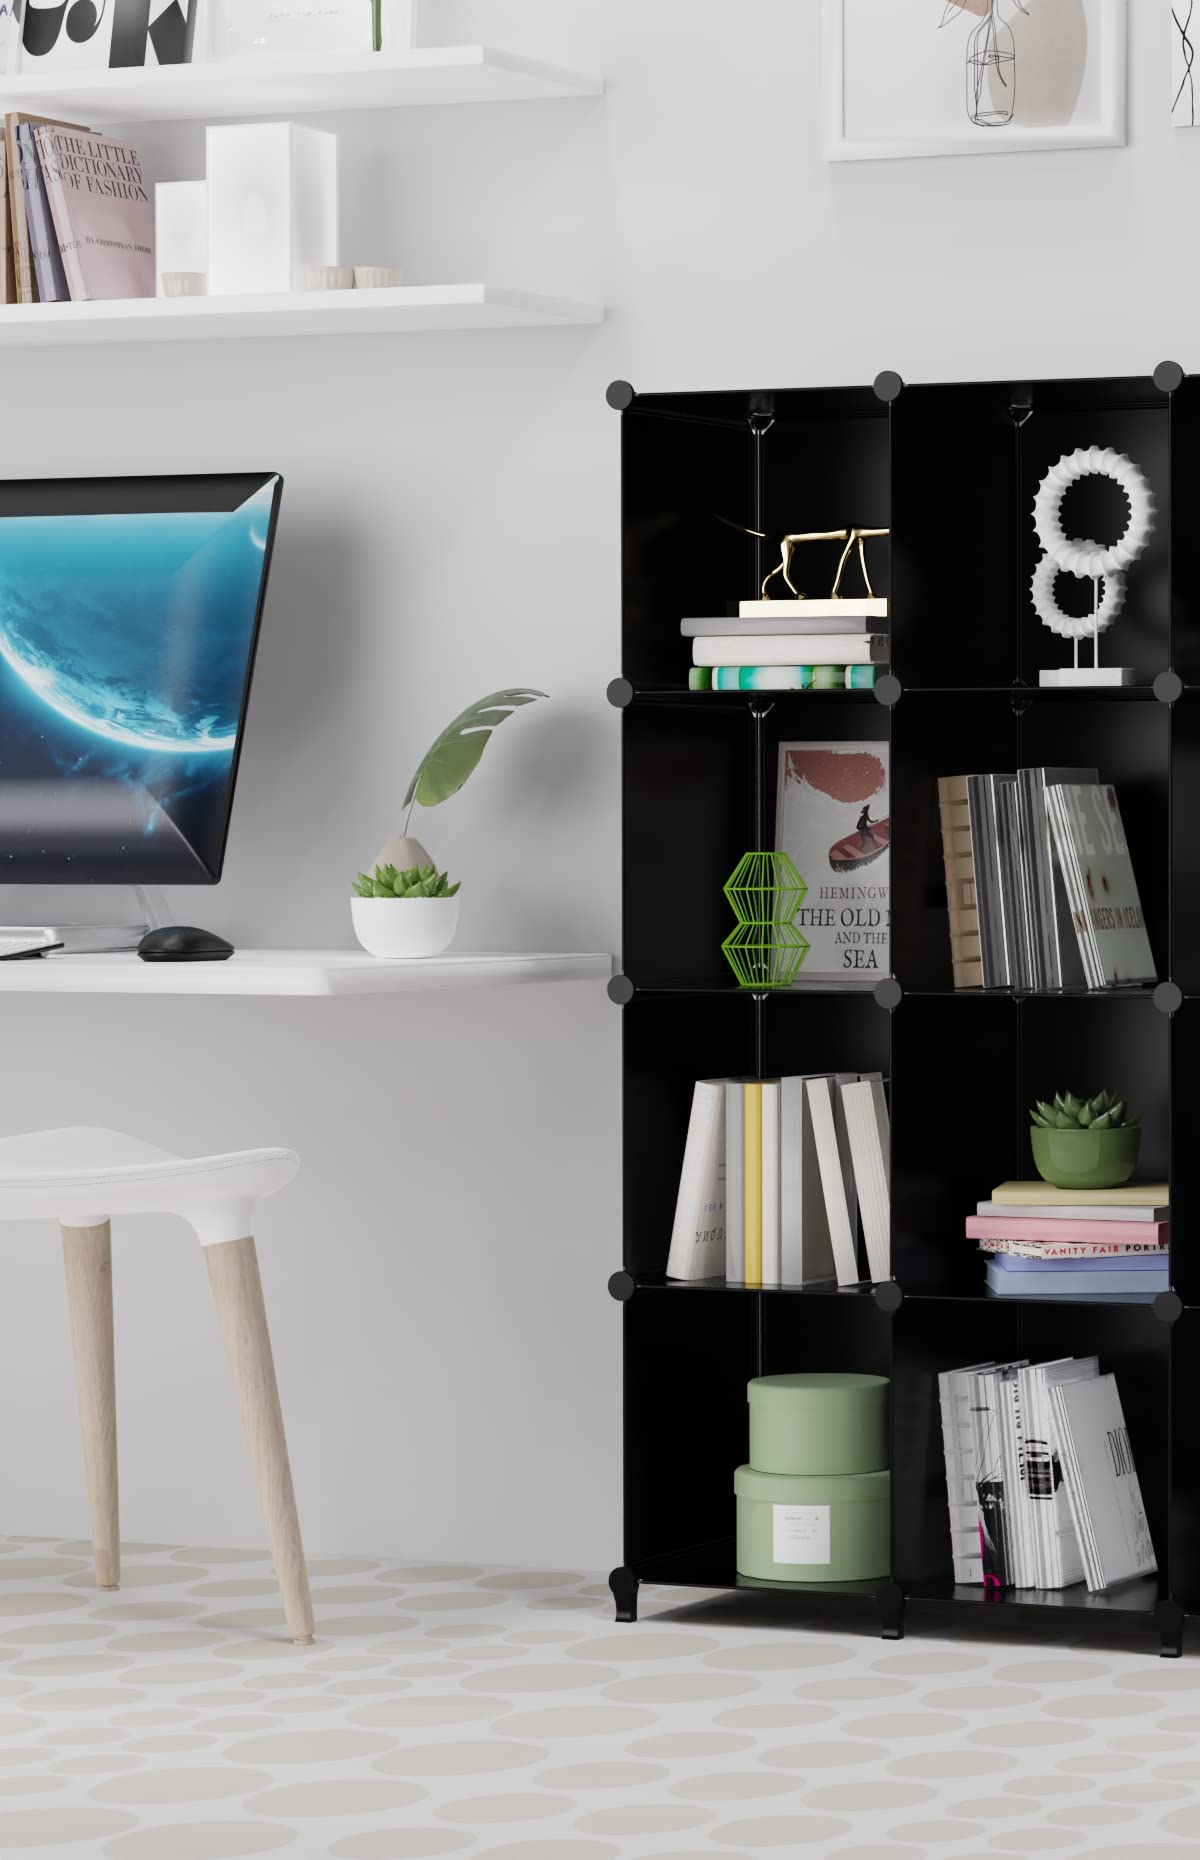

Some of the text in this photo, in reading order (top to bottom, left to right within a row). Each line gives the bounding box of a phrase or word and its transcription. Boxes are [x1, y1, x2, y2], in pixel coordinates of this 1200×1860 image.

[54, 135, 141, 166] THE LITTLE
[59, 153, 143, 184] DICTIONARY
[64, 172, 149, 202] OF FASHION
[85, 236, 95, 244] BY
[797, 907, 881, 927] THE OLD
[834, 931, 888, 944] AND THE
[843, 949, 878, 969] SEA
[1044, 1247, 1087, 1256] VANITY
[1092, 1245, 1120, 1254] FAIR
